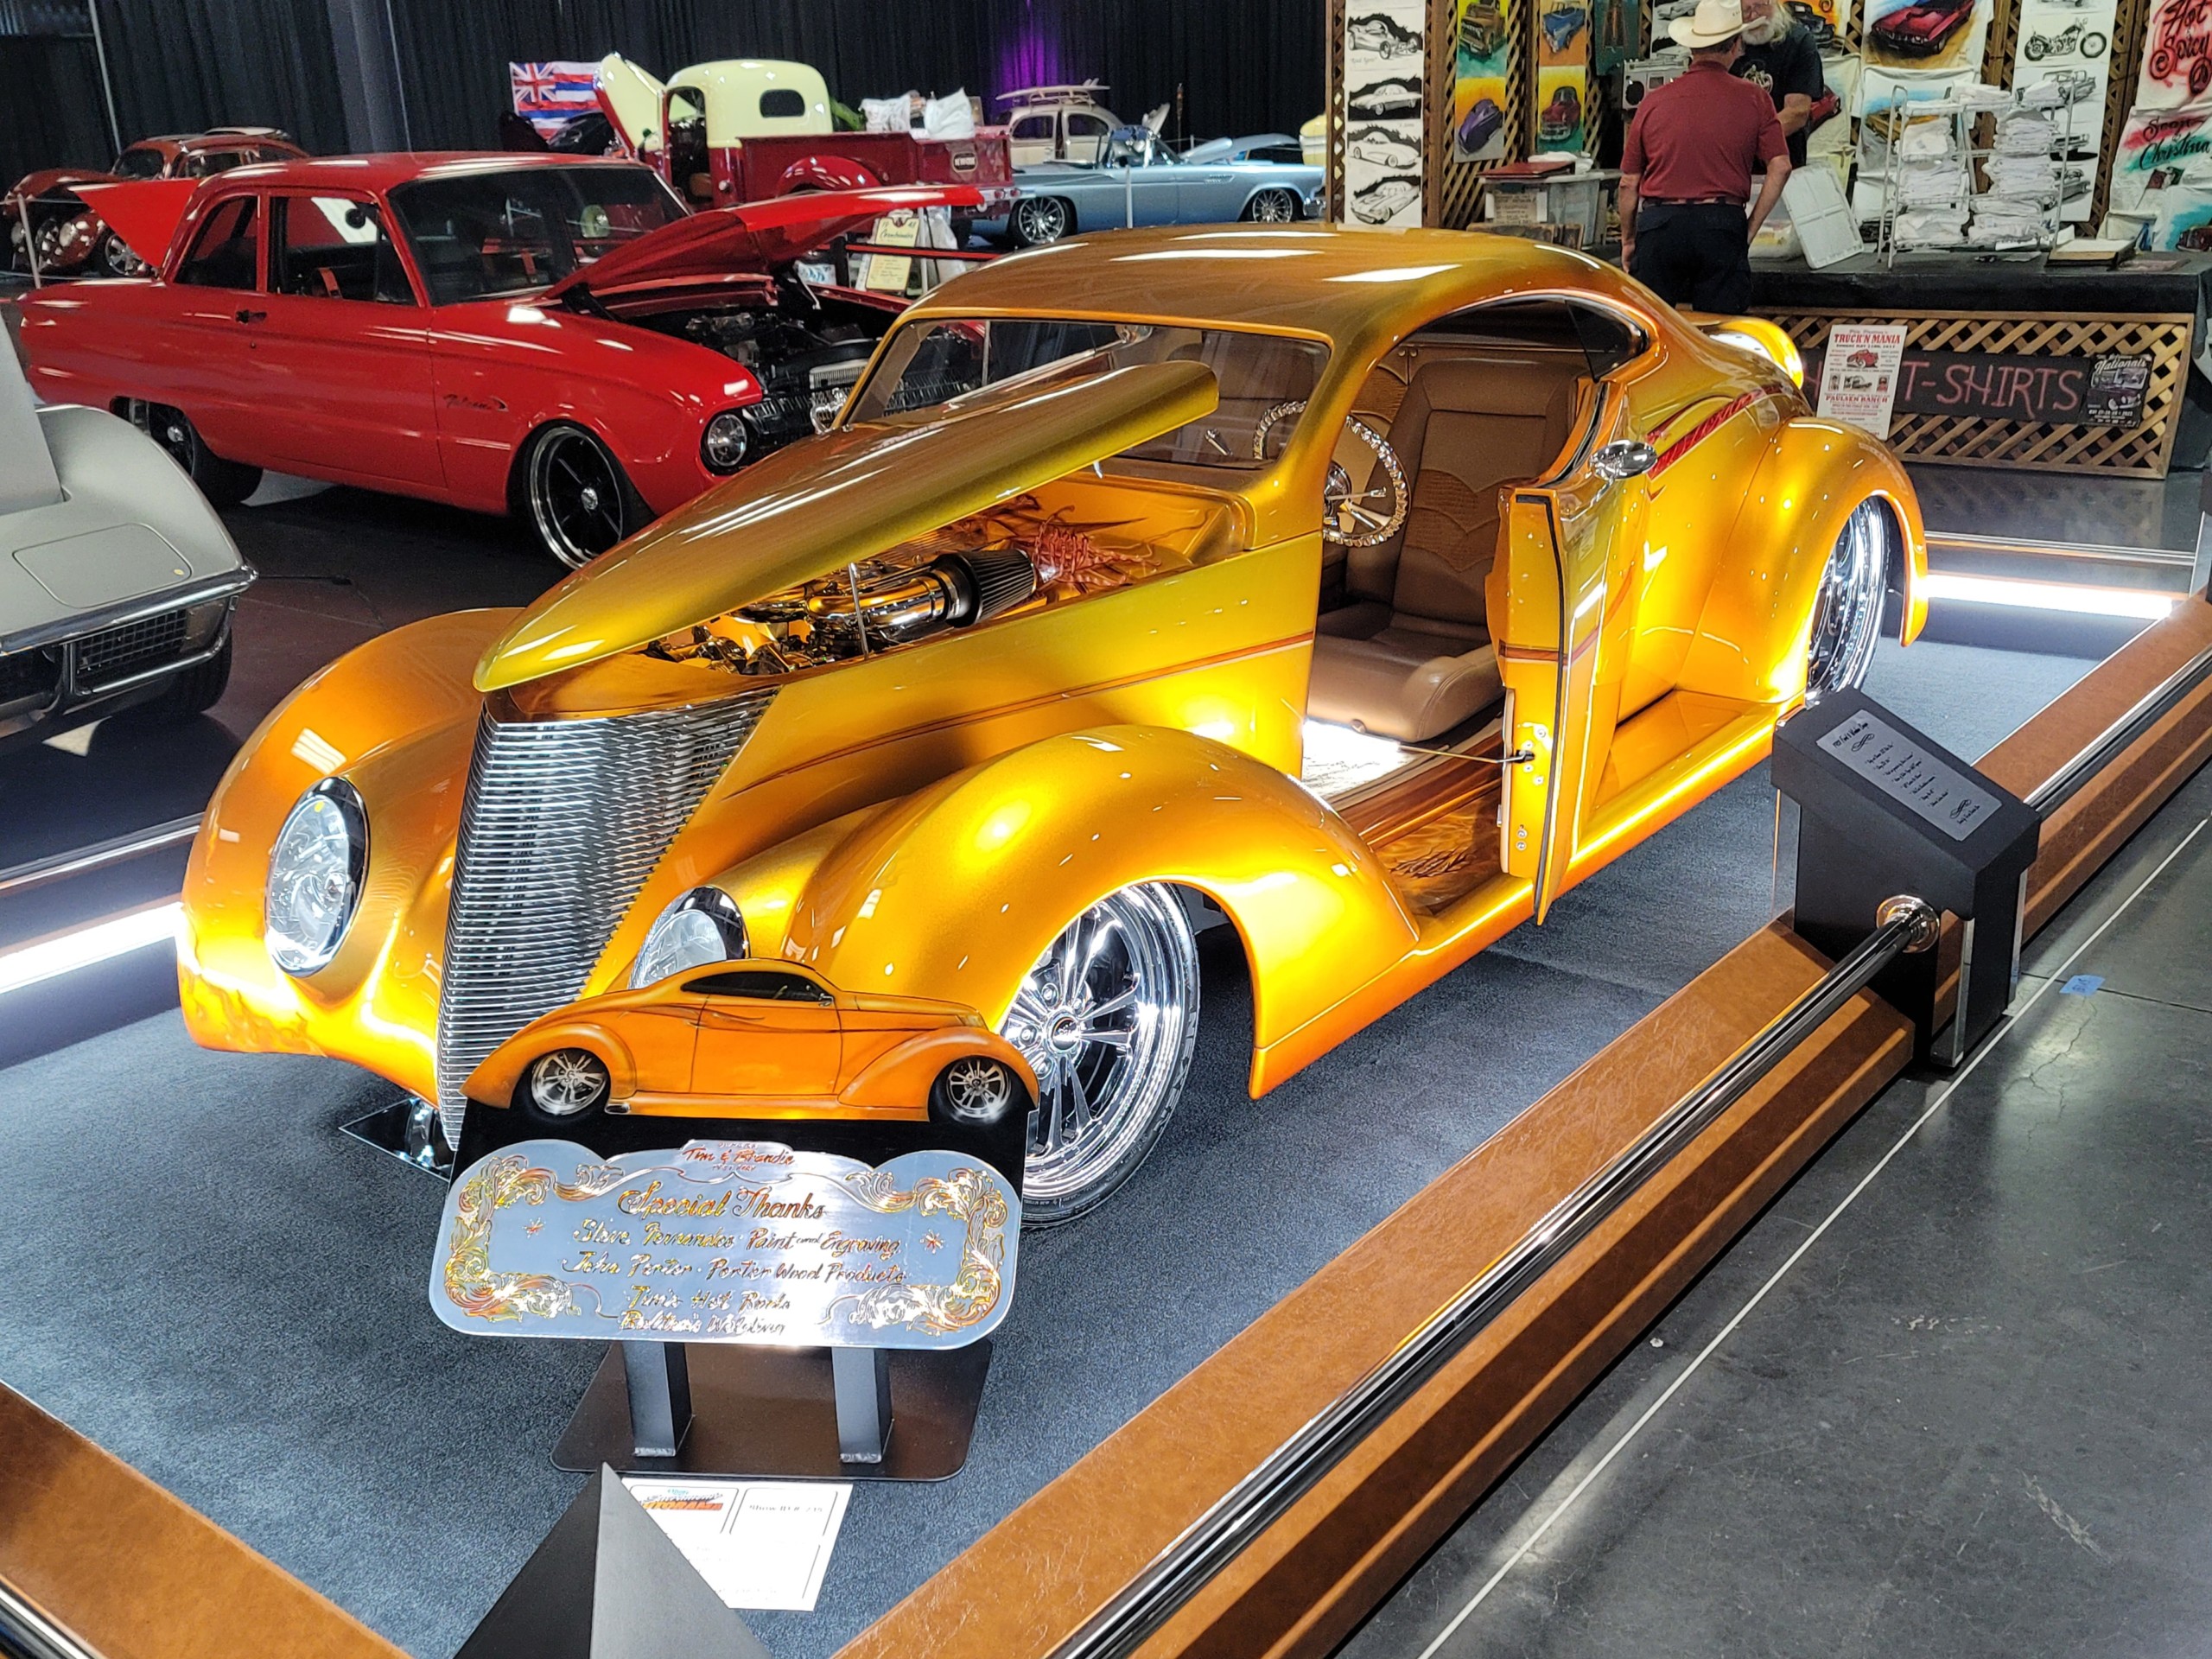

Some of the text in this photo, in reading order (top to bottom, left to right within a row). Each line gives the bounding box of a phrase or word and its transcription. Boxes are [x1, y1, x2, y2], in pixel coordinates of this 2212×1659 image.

[2162, 0, 2212, 35] Hot
[2139, 131, 2210, 170] Christina
[1834, 334, 1901, 344] TRUCK'N MANIA
[2094, 354, 2147, 374] Nationals
[1902, 360, 2083, 420] T-SHIRTS
[617, 1180, 826, 1220] Special Thanks
[746, 1227, 797, 1250] Paint
[821, 1230, 900, 1262] Engraving
[562, 1250, 907, 1283] John Porter Porter Wood Products
[691, 1289, 734, 1310] Hot
[641, 1500, 724, 1511] UTORAMA
